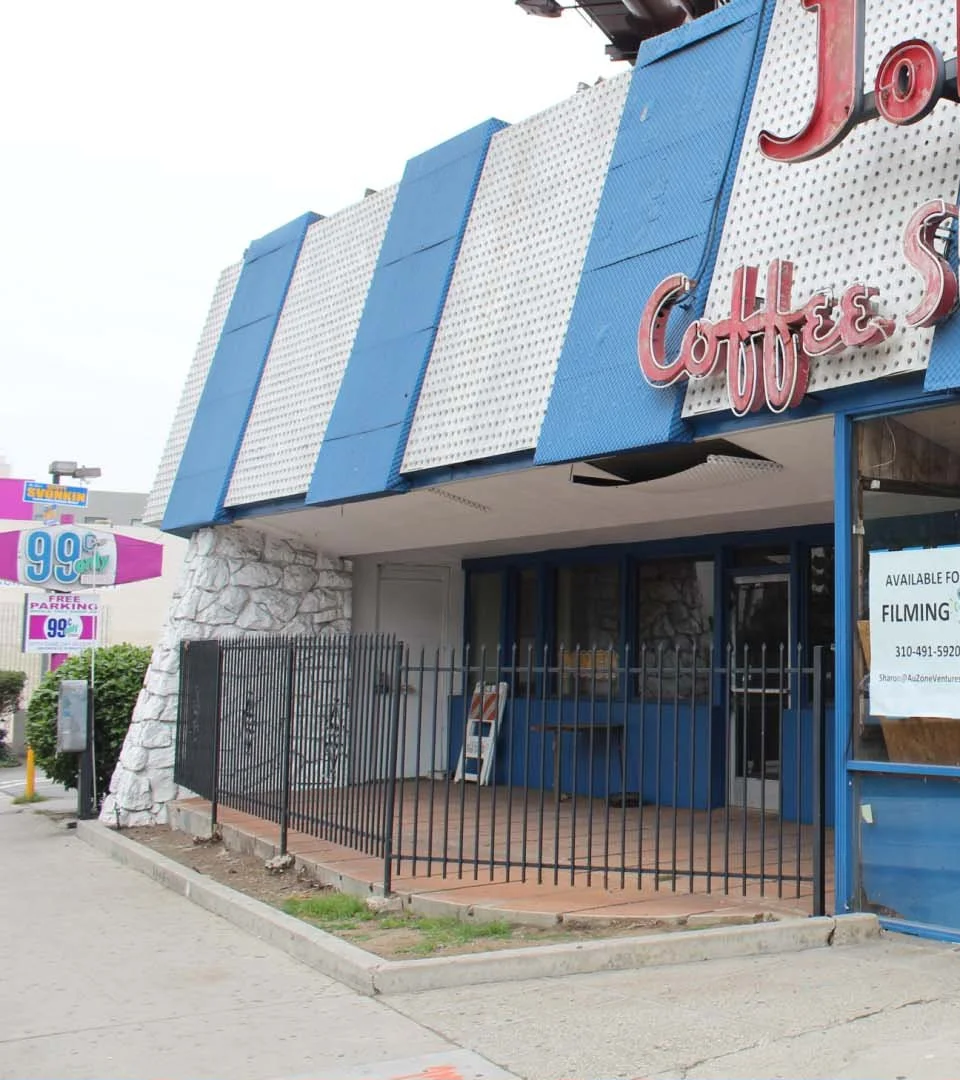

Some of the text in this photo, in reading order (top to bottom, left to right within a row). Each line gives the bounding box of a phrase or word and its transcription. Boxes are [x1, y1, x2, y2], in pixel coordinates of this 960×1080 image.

[638, 261, 895, 416] Coffee
[885, 571, 943, 587] AVAILABLE
[30, 602, 98, 610] PARKING
[49, 595, 81, 603] FREE
[882, 602, 950, 623] FILMING
[895, 645, 960, 658] 310-491-5920
